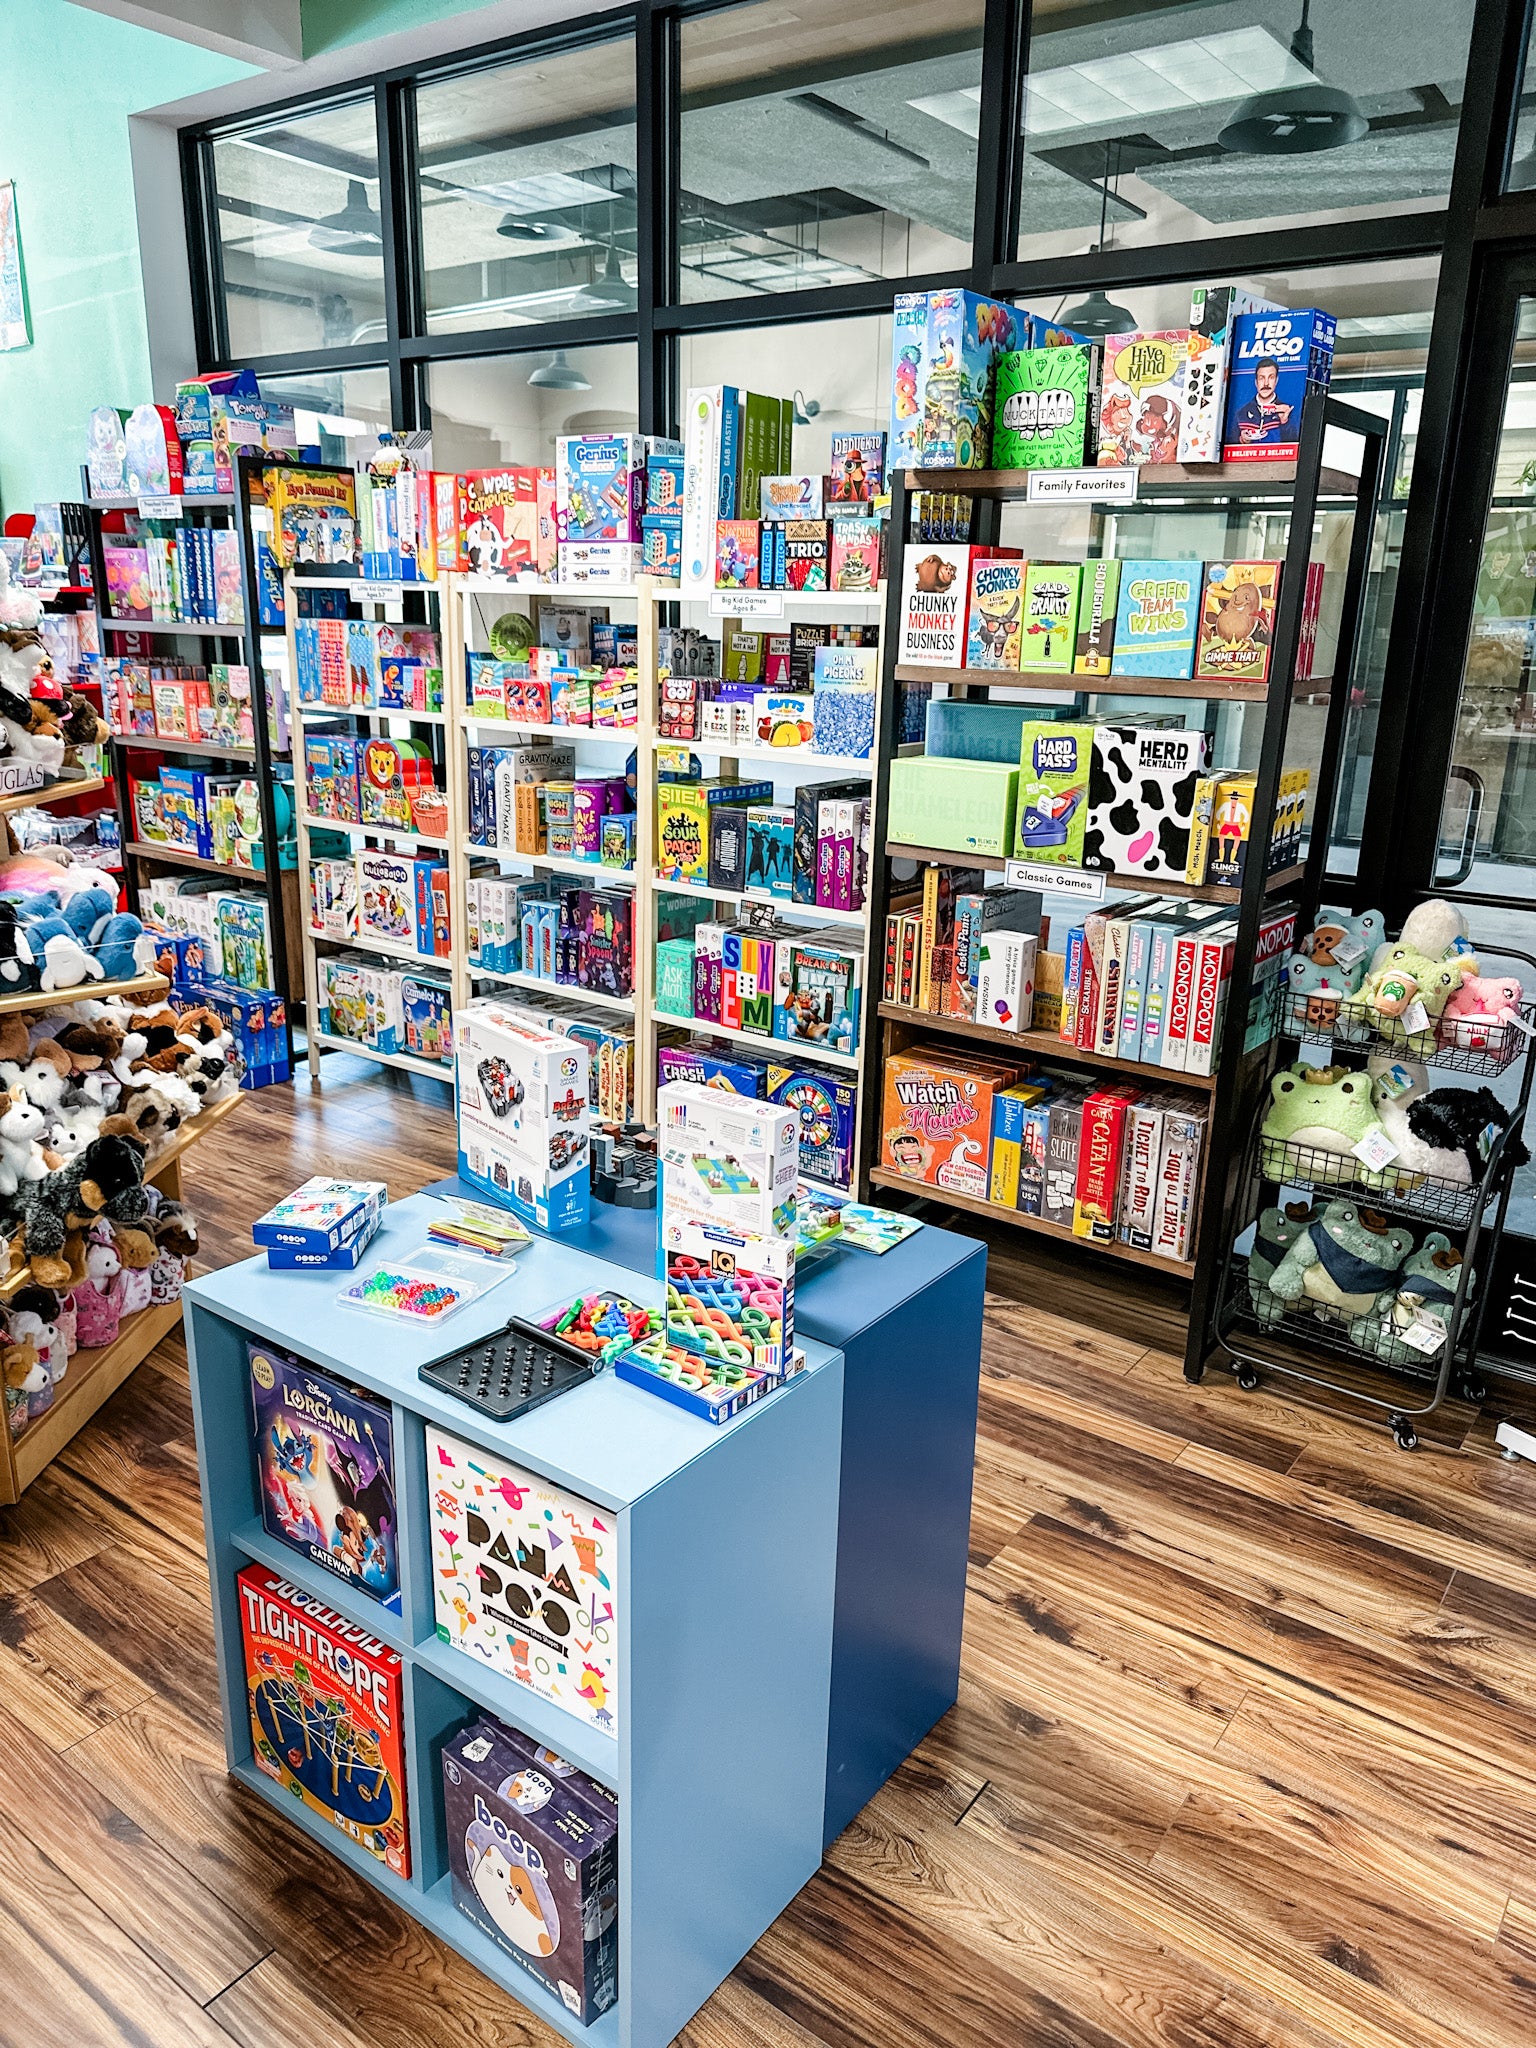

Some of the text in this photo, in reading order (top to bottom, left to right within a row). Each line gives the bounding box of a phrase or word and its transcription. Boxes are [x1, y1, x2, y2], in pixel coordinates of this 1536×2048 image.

[1255, 320, 1291, 339] TED
[1239, 336, 1303, 358] LASSO
[1004, 407, 1074, 421] NUCK TATS
[724, 409, 733, 447] FASTER!
[576, 447, 618, 461] Genius
[924, 454, 955, 465] KOSMOS
[286, 484, 347, 500] Eye Found It!
[437, 481, 455, 502] POP
[720, 473, 733, 516] GIBGAB
[799, 477, 813, 503] 2
[1038, 478, 1126, 494] Family Favorites
[468, 494, 516, 513] CATAPULTS
[438, 509, 454, 533] OFF!
[836, 522, 869, 535] TRASH
[836, 533, 872, 547] PANDAS
[589, 547, 611, 555] Genius
[763, 539, 772, 574] TRIO
[788, 543, 824, 558] TRIO
[976, 567, 1020, 583] CHONKY
[976, 578, 1021, 597] DONKEY
[1131, 582, 1187, 599] GREEN
[722, 597, 733, 605] Big
[733, 605, 748, 613] Ages
[910, 596, 958, 612] CHUNKY
[1029, 600, 1070, 615] GRAVITY
[1140, 599, 1174, 615] TEAM
[908, 613, 956, 630] MONKEY
[1131, 612, 1186, 634] WINS
[795, 639, 825, 647] BRIGHT
[796, 628, 825, 640] PUZZLE
[907, 633, 955, 650] BUSINESS
[832, 655, 858, 664] OH MY
[1205, 651, 1260, 663] GIMME THAT!
[823, 665, 865, 679] PIGEONS!
[667, 687, 691, 700] GO!
[767, 699, 805, 713] BUTTS
[711, 723, 728, 732] EZ2C
[1038, 739, 1072, 754] HARD
[1141, 741, 1189, 760] HERD
[519, 754, 572, 765] GRAVITY MAZE
[1038, 754, 1071, 768] PASS
[1139, 759, 1187, 770] MENTALITY
[385, 789, 404, 799] Lion
[502, 773, 511, 843] GRAVITY MAZE
[664, 826, 698, 840] SOUR
[664, 840, 701, 855] PATCH
[820, 843, 828, 875] Genius
[837, 845, 846, 877] Genius
[1211, 862, 1240, 873] SLINGZ
[690, 878, 707, 886] GAME
[1017, 871, 1093, 889] Classic Games
[924, 918, 933, 950] CHESS
[956, 911, 971, 975] Castle Panic
[588, 949, 613, 961] Spoons
[795, 953, 849, 975] BREAK-OUT
[663, 965, 683, 983] ASK
[710, 965, 718, 994] Genius
[405, 981, 445, 1007] Camelot Jr
[1066, 985, 1079, 1005] Pigs
[1082, 969, 1092, 1015] SCRABBLE
[1172, 947, 1193, 1034] MONOPOLY
[1196, 950, 1217, 1042] MONOPOLY
[1123, 990, 1140, 1030] LIFE
[1146, 994, 1162, 1035] LIFE
[1064, 1016, 1072, 1035] Pass
[663, 1064, 706, 1083] CRASH
[768, 1068, 782, 1081] 6th
[836, 1088, 850, 1098] 150
[898, 1082, 957, 1104] Watch
[553, 1097, 587, 1114] BREAK
[802, 1112, 813, 1121] OF
[907, 1102, 977, 1139] Mouth
[1002, 1098, 1019, 1135] Yahtzee
[827, 1145, 846, 1156] GAME
[1051, 1138, 1077, 1162] SLATE
[1090, 1123, 1110, 1178] CATAN
[775, 1168, 797, 1185] SHEEP
[941, 1174, 949, 1182] 10
[955, 1164, 985, 1176] CATEGORIES
[1132, 1120, 1156, 1218] TICKET TO RIDE
[1022, 1193, 1037, 1202] USA
[1158, 1149, 1183, 1246] TICKET TO RIDE
[713, 1251, 734, 1272] IQ
[256, 1364, 270, 1374] LEARN
[304, 1379, 332, 1405] Disney
[283, 1384, 360, 1443] LORCANA
[296, 1411, 347, 1441] TRADING CARD GAME
[310, 1545, 351, 1576] GATEWAY
[466, 1510, 582, 1606] PANA
[504, 1617, 513, 1625] the
[513, 1621, 530, 1634] Answer
[530, 1629, 542, 1640] Takes
[241, 1585, 391, 1728] TIGHTROPE
[261, 1637, 297, 1656] UNPREDICTABLE
[298, 1652, 312, 1666] GAME
[313, 1661, 320, 1669] OF
[321, 1666, 350, 1694] BALANCING
[351, 1690, 362, 1704] AND
[362, 1703, 390, 1737] BLOCKING
[526, 1771, 553, 1795] boop
[464, 1907, 476, 1921] Very
[497, 1936, 512, 1954] Game
[513, 1951, 522, 1962] For
[527, 1965, 545, 1982] Clever
[545, 1981, 559, 1995] Cats
